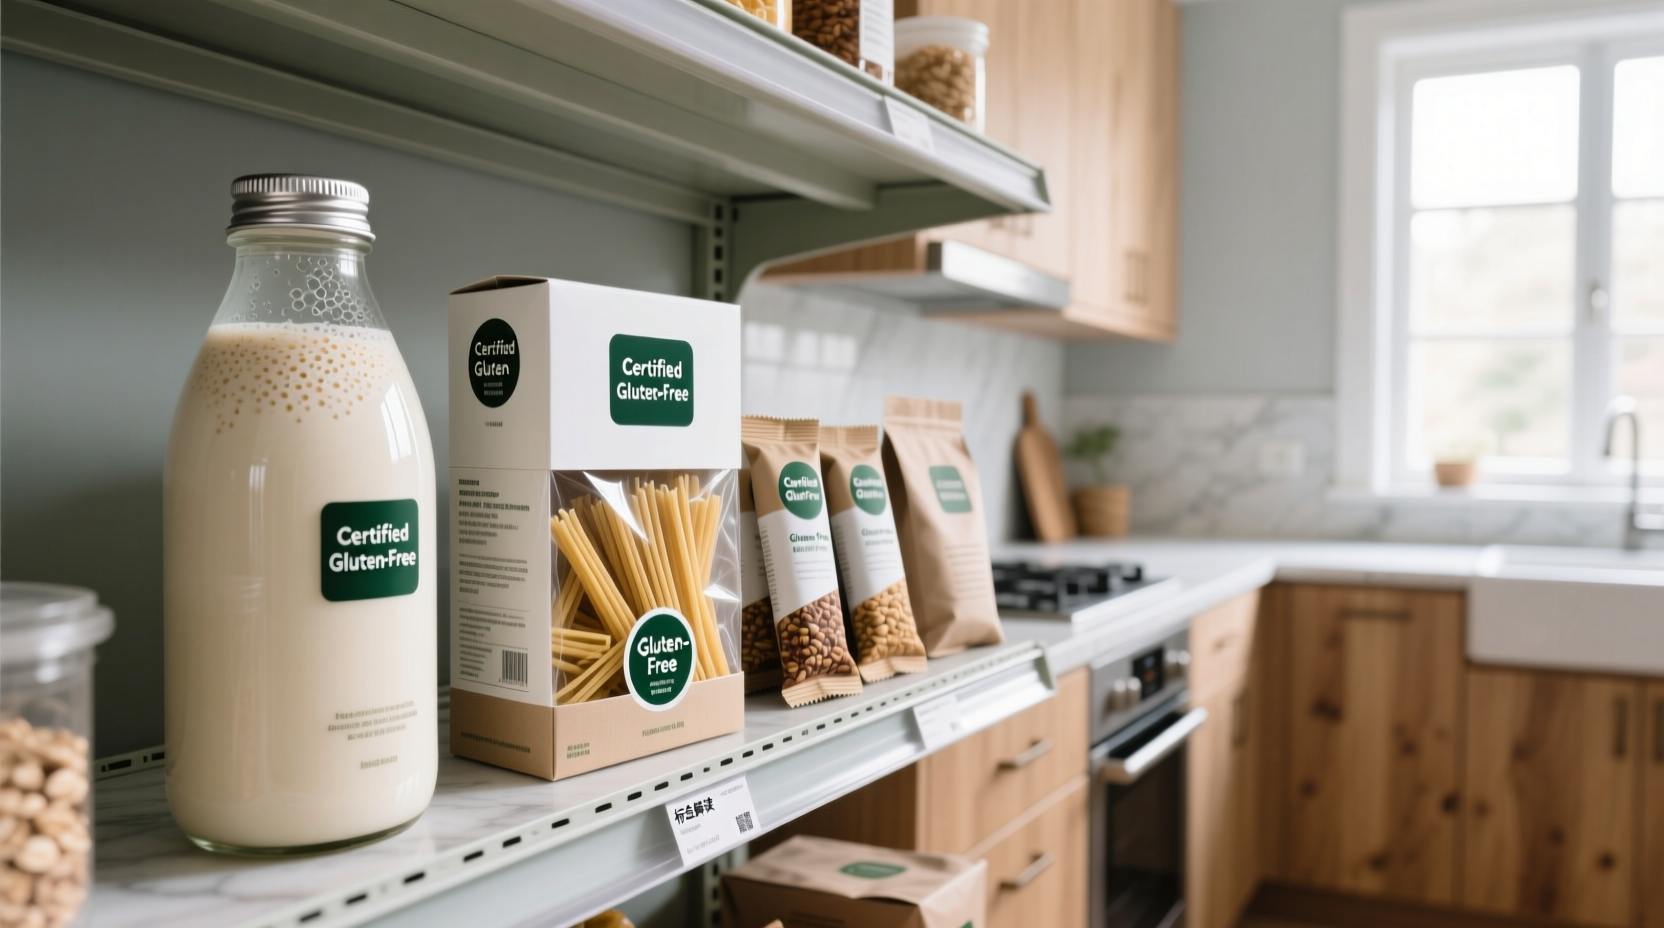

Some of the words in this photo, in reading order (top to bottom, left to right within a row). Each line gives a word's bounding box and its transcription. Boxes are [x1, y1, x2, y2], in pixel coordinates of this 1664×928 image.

[622, 357, 683, 379] Certified
[336, 522, 410, 546] Certified
[328, 548, 417, 573] Gluten-Free
[636, 635, 690, 657] Gluten-
[647, 656, 678, 675] Free
